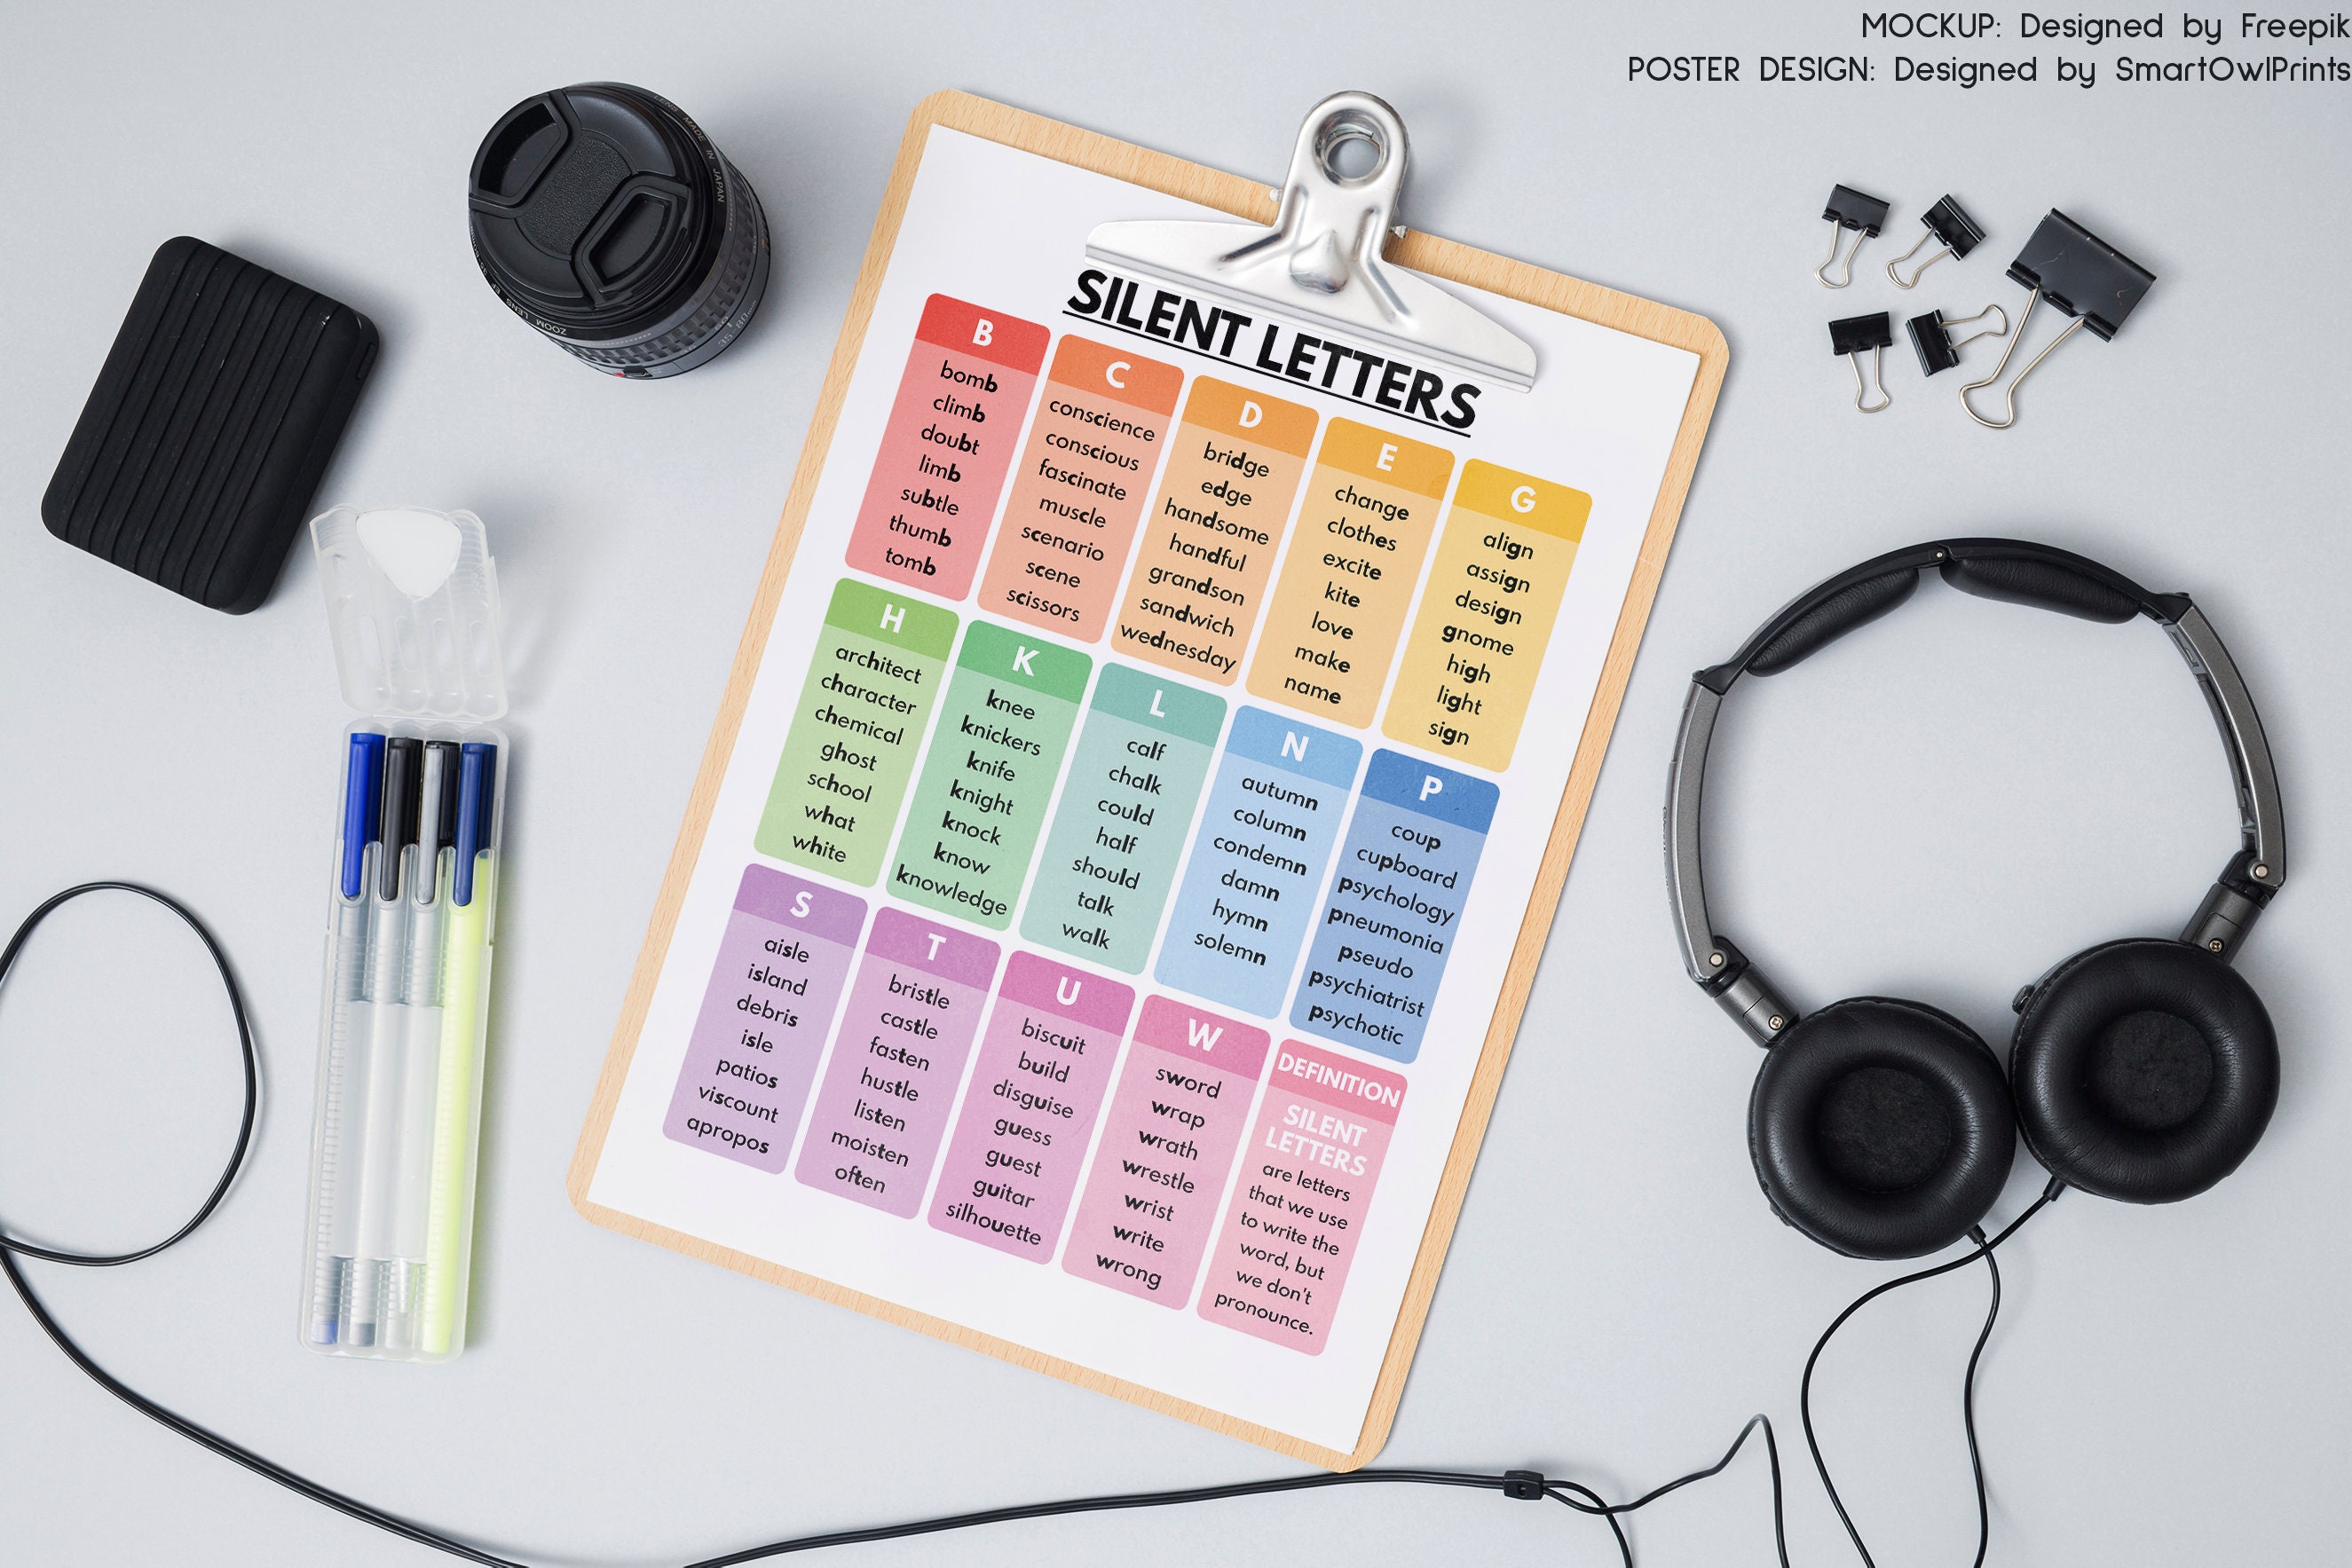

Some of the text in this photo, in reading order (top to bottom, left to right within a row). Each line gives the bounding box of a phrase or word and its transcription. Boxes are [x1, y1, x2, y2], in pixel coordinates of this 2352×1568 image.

[653, 95, 726, 202] LENS MADE IN JAPAN
[491, 282, 501, 295] EF
[506, 298, 529, 319] LENS
[536, 319, 567, 335] ZOOM
[972, 319, 994, 347] B
[1067, 269, 1482, 429] SILENT LETTERS
[940, 359, 998, 393] bomb
[1105, 361, 1132, 389] C
[933, 394, 986, 423] climb
[1049, 400, 1156, 442] conscience
[1238, 400, 1263, 429] D
[920, 423, 980, 456] doubt
[1046, 433, 1140, 471] conscious
[919, 453, 961, 483] limb
[1203, 440, 1269, 478] bridge
[1377, 443, 1398, 471] E
[1038, 458, 1126, 501] fascinate
[1201, 480, 1252, 507] edge
[900, 488, 959, 516] subtle
[1039, 498, 1106, 529] muscle
[1334, 485, 1409, 522] change
[1511, 485, 1536, 514] G
[889, 514, 951, 548] thumb
[1164, 496, 1269, 546] handsome
[1327, 516, 1397, 551] clothes
[1021, 526, 1104, 562] scenario
[1169, 532, 1247, 572] handful
[1483, 532, 1534, 561] align
[885, 548, 936, 576] tomb
[1025, 562, 1081, 588] scene
[1322, 553, 1382, 580] excite
[1466, 563, 1530, 594] assign
[1148, 567, 1245, 606] grandson
[1324, 580, 1361, 608] kite
[880, 603, 906, 634] H
[1006, 589, 1080, 622] scissors
[1140, 598, 1235, 637] sandwich
[1455, 589, 1522, 626] design
[1311, 611, 1354, 640] love
[1440, 625, 1514, 656] gnome
[1012, 645, 1039, 677] K
[1121, 624, 1237, 674] wednesday
[1295, 646, 1351, 674] make
[835, 648, 922, 684] architect
[1446, 653, 1491, 684] high
[821, 673, 917, 715] character
[986, 688, 1035, 720] knee
[1149, 689, 1165, 718] L
[1284, 677, 1341, 705] name
[1436, 684, 1482, 716] light
[815, 704, 904, 745] chemical
[960, 714, 1041, 756] knickers
[1428, 721, 1470, 746] sign
[820, 741, 877, 772] ghost
[1126, 741, 1167, 761] calf
[1281, 731, 1310, 762] N
[966, 750, 1015, 782] knife
[1109, 765, 1163, 795] chalk
[807, 772, 872, 803] school
[950, 778, 1014, 816] knight
[1242, 777, 1319, 811] autumn
[1419, 775, 1443, 801] P
[804, 805, 856, 832] what
[941, 810, 1001, 846] knock
[1097, 800, 1155, 826] could
[1234, 808, 1306, 842] column
[793, 835, 847, 863] white
[1095, 826, 1139, 855] half
[1391, 825, 1441, 854] coup
[933, 841, 991, 875] know
[1072, 855, 1140, 890] should
[1213, 837, 1307, 876] condemn
[1356, 848, 1458, 889] cupboard
[896, 863, 1007, 916] knowledge
[1221, 869, 1280, 902] damn
[1337, 877, 1456, 926] psychology
[789, 891, 814, 918] S
[1077, 891, 1115, 917] talk
[1212, 897, 1268, 933] hymn
[927, 933, 947, 961] T
[1062, 923, 1110, 949] walk
[1327, 907, 1444, 955] pneumonia
[764, 938, 809, 963] aisle
[1194, 934, 1267, 966] solemn
[1337, 945, 1414, 979] pseudo
[747, 963, 809, 997] island
[888, 973, 950, 1010] bristle
[1056, 976, 1082, 1005] U
[1307, 970, 1425, 1018] psychiatrist
[737, 994, 799, 1028] debris
[880, 1013, 938, 1040] castle
[1307, 1005, 1404, 1045] psychotic
[740, 1028, 773, 1053] isle
[1021, 1017, 1086, 1055] biscuit
[1188, 1018, 1224, 1052] W
[869, 1036, 930, 1072] fasten
[1018, 1051, 1070, 1083] build
[715, 1059, 778, 1089] patios
[860, 1067, 919, 1102] hustle
[1156, 1068, 1222, 1099] sword
[1277, 1052, 1401, 1108] DEFINITION
[698, 1086, 779, 1123] viscount
[853, 1099, 905, 1132] listen
[993, 1079, 1074, 1119] disguise
[1151, 1100, 1205, 1131] wrap
[687, 1117, 770, 1154] apropos
[993, 1118, 1052, 1146] guess
[1283, 1105, 1368, 1146] SILENT
[831, 1131, 909, 1168] moisten
[1139, 1131, 1198, 1161] wrath
[1265, 1126, 1367, 1176] LETTERS
[834, 1165, 886, 1194] often
[984, 1150, 1042, 1178] guest
[1122, 1159, 1195, 1194] wrestle
[972, 1180, 1036, 1208] guitar
[1262, 1165, 1350, 1202] are letters
[945, 1202, 1042, 1246] silhouette
[1125, 1194, 1174, 1222] wrist
[1249, 1185, 1348, 1230] that we use
[1113, 1225, 1164, 1252] write
[1241, 1211, 1339, 1256] to write the
[1096, 1254, 1162, 1291] wrong
[1240, 1243, 1325, 1280] word, but
[1236, 1270, 1312, 1305] we don't
[1214, 1293, 1314, 1336] pronounce.
